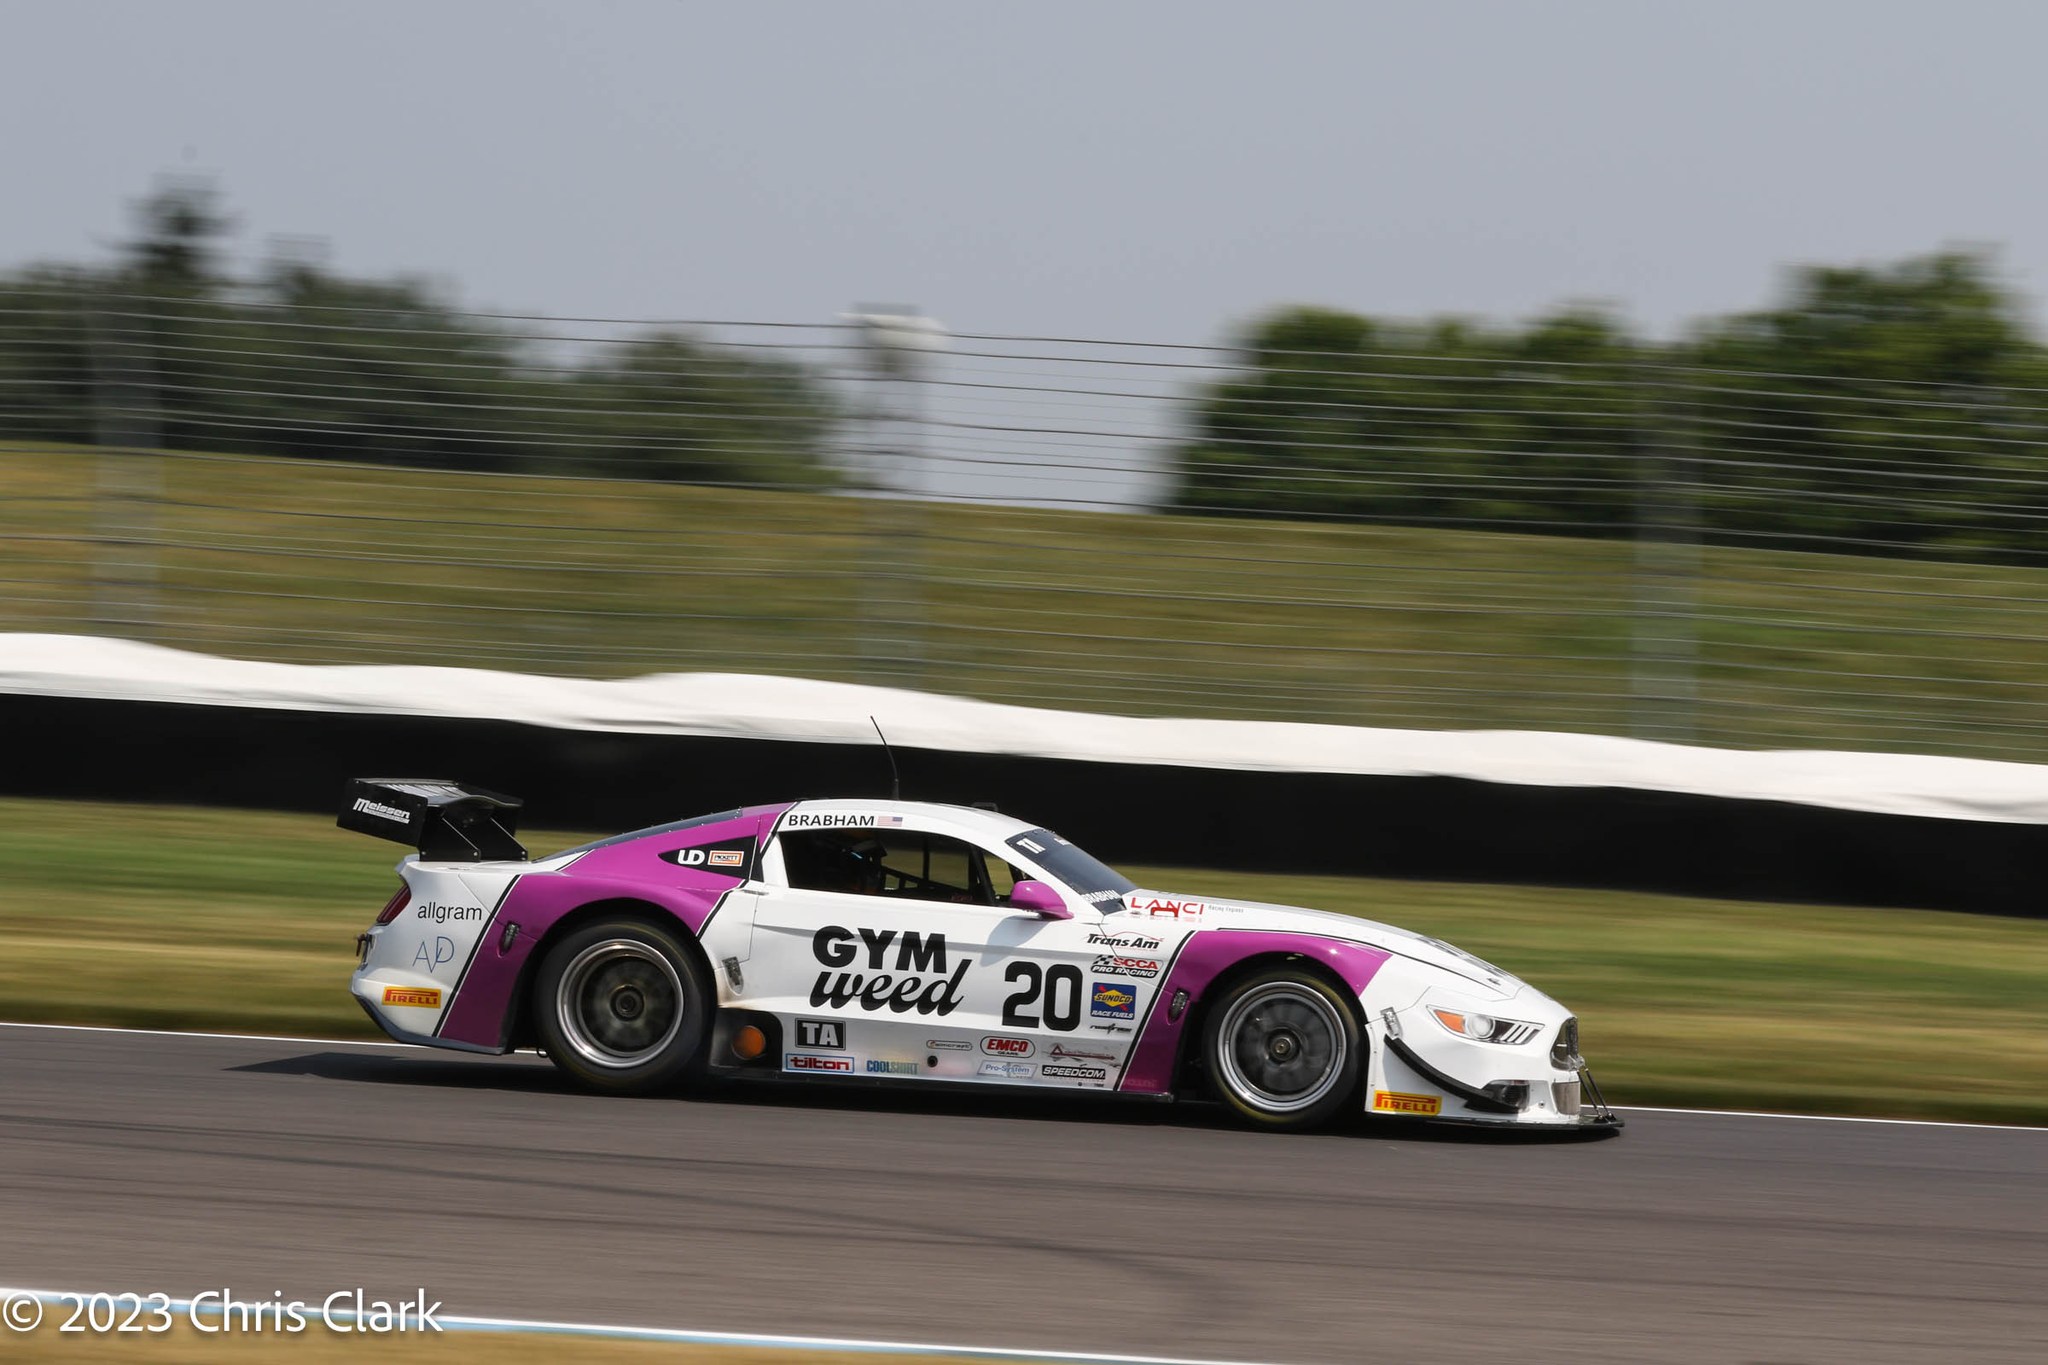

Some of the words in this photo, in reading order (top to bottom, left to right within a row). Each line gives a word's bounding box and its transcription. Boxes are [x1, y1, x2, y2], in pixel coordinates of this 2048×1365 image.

[353, 797, 411, 819] Meissen
[788, 814, 875, 826] BRABHAM
[417, 901, 483, 924] allgram
[1131, 897, 1204, 917] LANCI
[1087, 933, 1130, 947] Trans
[1130, 938, 1160, 949] Am
[812, 925, 948, 974] GYM
[1113, 957, 1159, 970] SCCA
[1115, 968, 1156, 977] RACING
[809, 958, 973, 1016] weed
[384, 989, 439, 1005] PIRELLI
[1001, 960, 1083, 1032] 20
[1096, 993, 1132, 1003] SUNOCO
[1091, 1009, 1112, 1017] RACE
[801, 1022, 839, 1046] TA
[987, 1038, 1029, 1053] EMCO
[790, 1056, 850, 1071] tilton
[1376, 1093, 1437, 1113] PIRELLI
